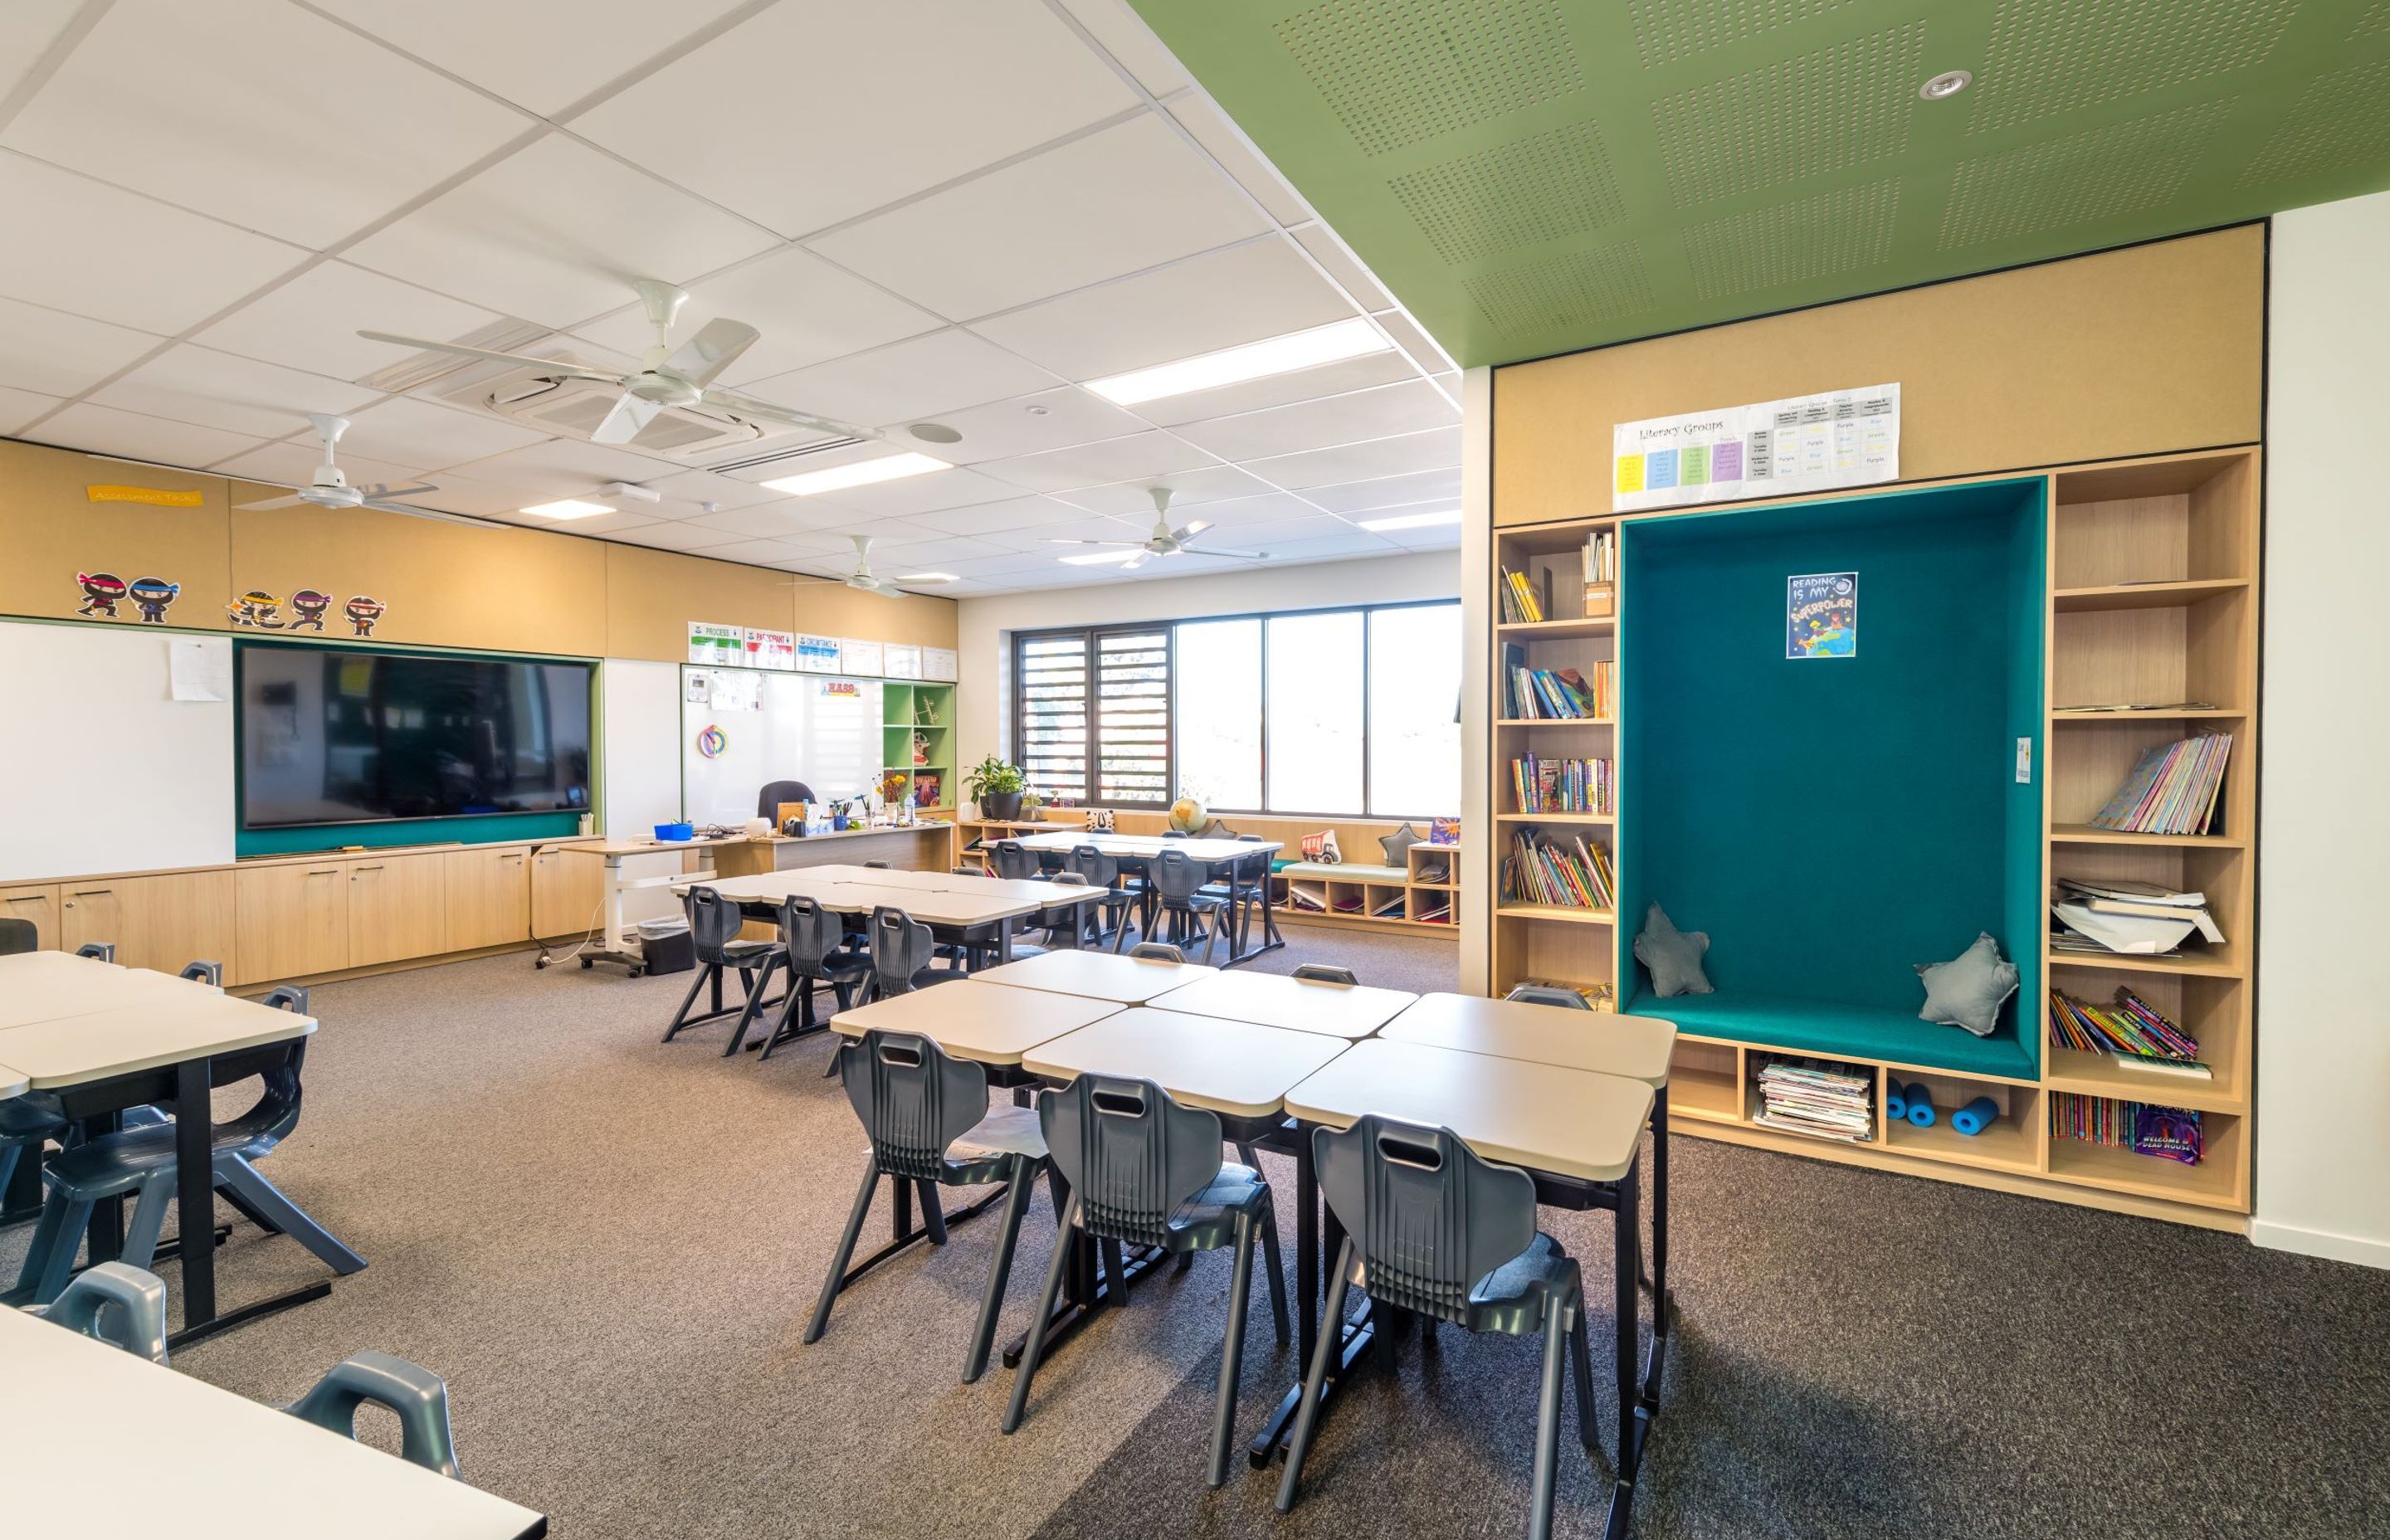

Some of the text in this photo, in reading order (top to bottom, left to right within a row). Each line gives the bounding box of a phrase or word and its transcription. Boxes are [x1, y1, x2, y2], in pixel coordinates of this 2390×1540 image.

[1639, 420, 1724, 440] Literacy Groups
[1792, 577, 1836, 588] READING
[1793, 586, 1829, 601] IS MY
[1791, 597, 1853, 623] SUPERPOWER
[706, 627, 729, 637] PROCESS
